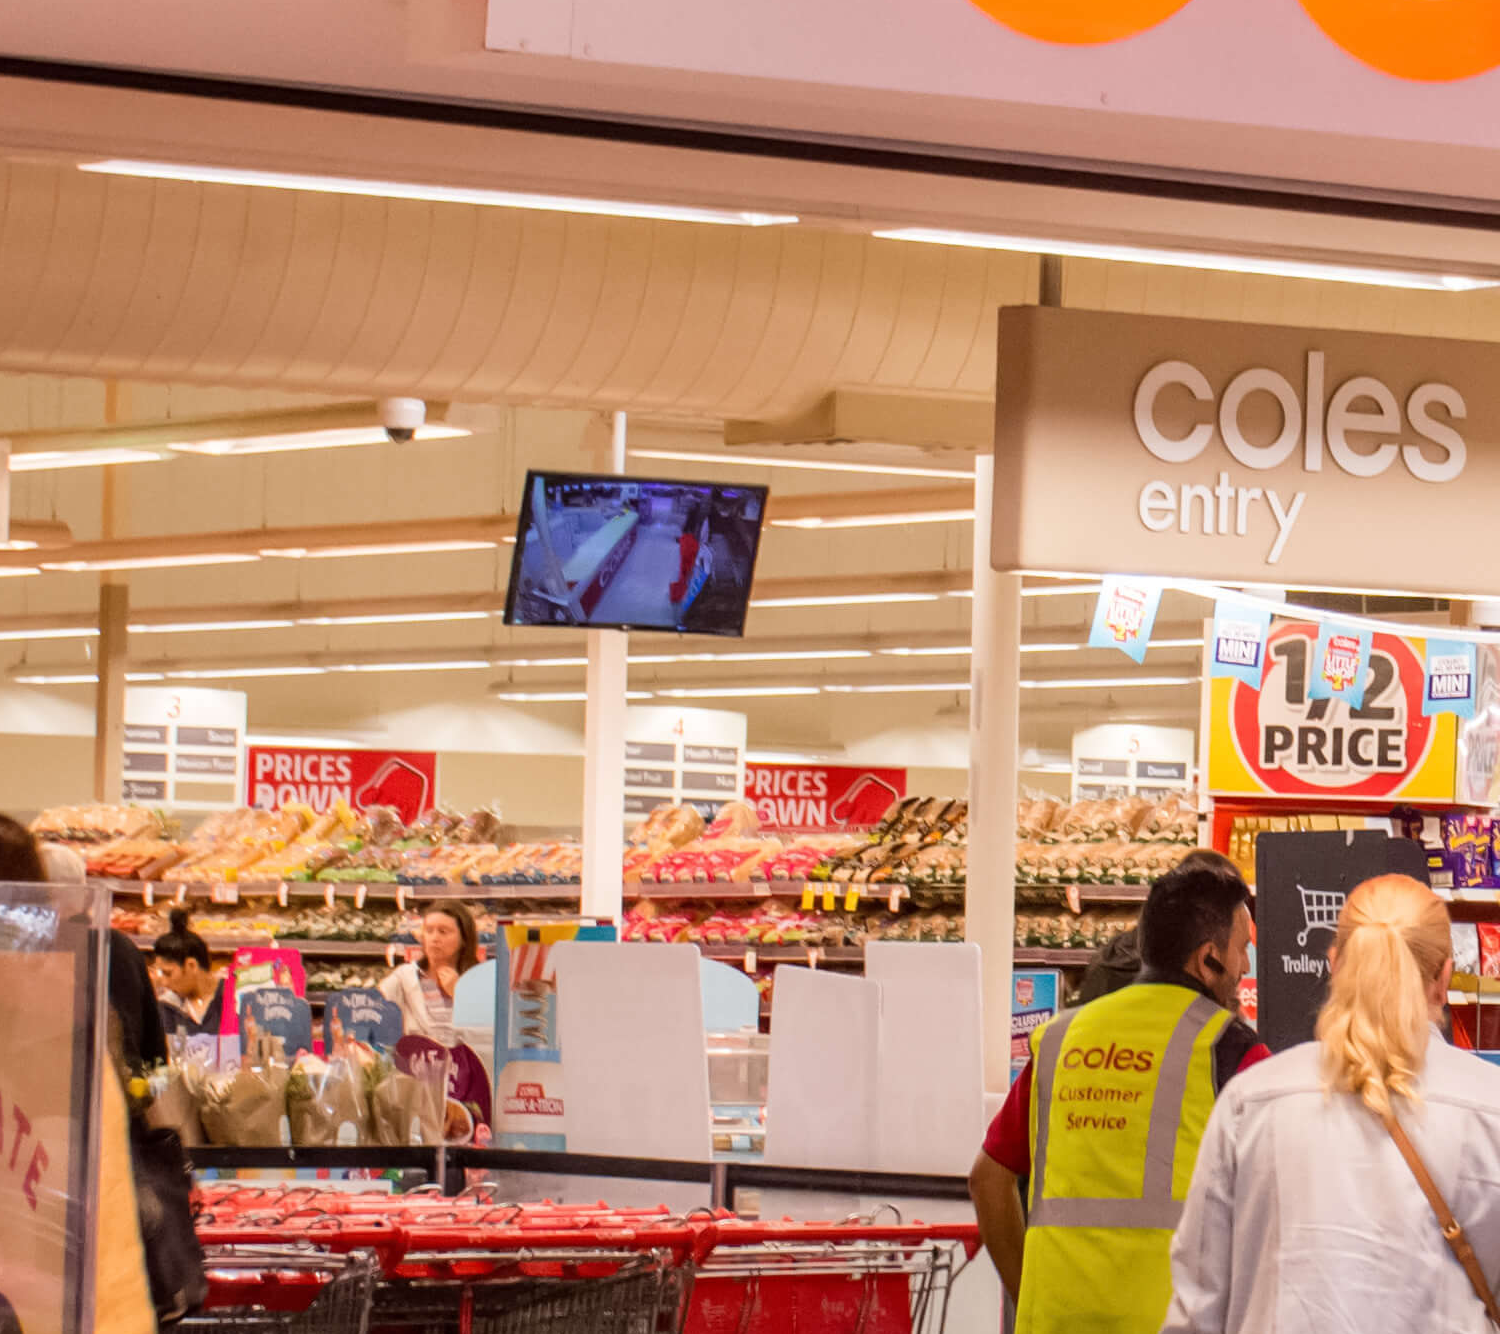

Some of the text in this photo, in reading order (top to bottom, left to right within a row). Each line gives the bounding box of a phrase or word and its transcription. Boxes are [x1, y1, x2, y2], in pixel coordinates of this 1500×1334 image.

[1133, 351, 1467, 483] coles
[1138, 472, 1307, 564] entry
[1431, 674, 1469, 694] MINI
[1264, 726, 1404, 768] PRICE
[255, 753, 351, 782] PRICES
[255, 783, 350, 814] DOWN
[1282, 954, 1325, 978] Trolley
[1062, 1042, 1155, 1073] coles
[1058, 1084, 1144, 1104] Customer
[1064, 1112, 1128, 1131] Service
